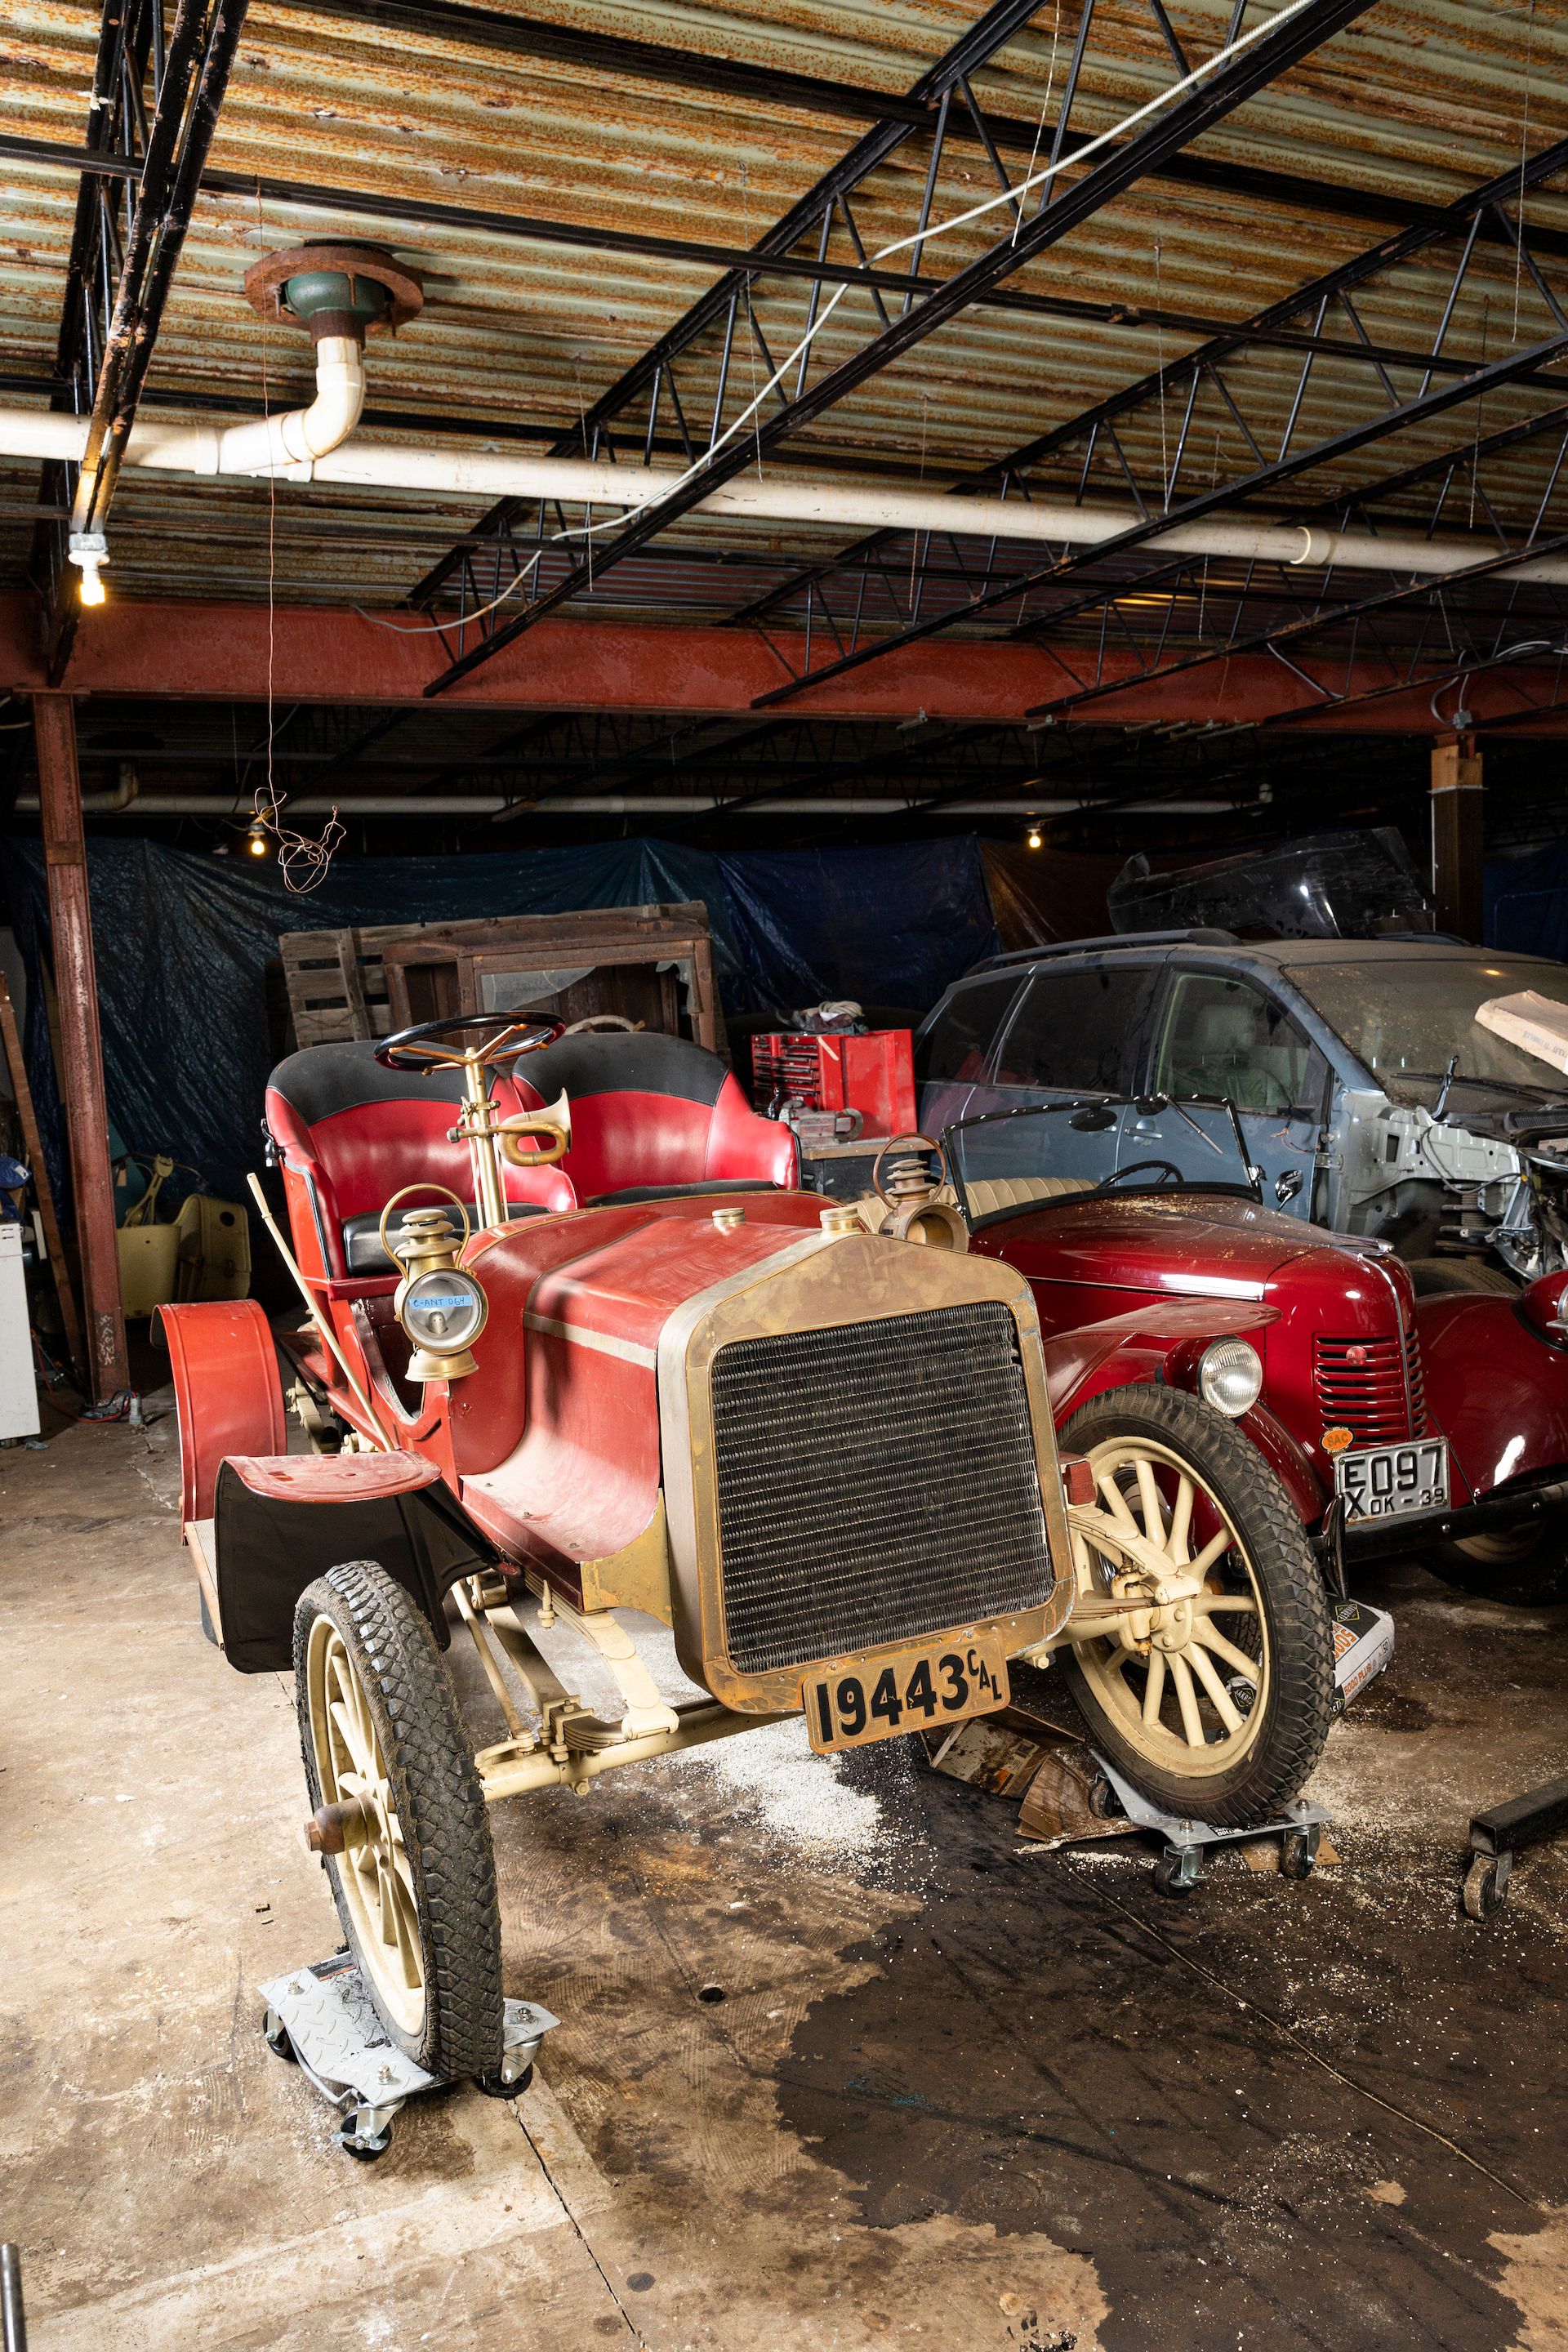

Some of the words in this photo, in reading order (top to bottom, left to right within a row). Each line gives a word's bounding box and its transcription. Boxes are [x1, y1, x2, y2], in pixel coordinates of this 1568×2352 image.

[448, 1297, 465, 1306] 064
[1327, 1431, 1348, 1447] SAC
[817, 1654, 969, 1743] 19443
